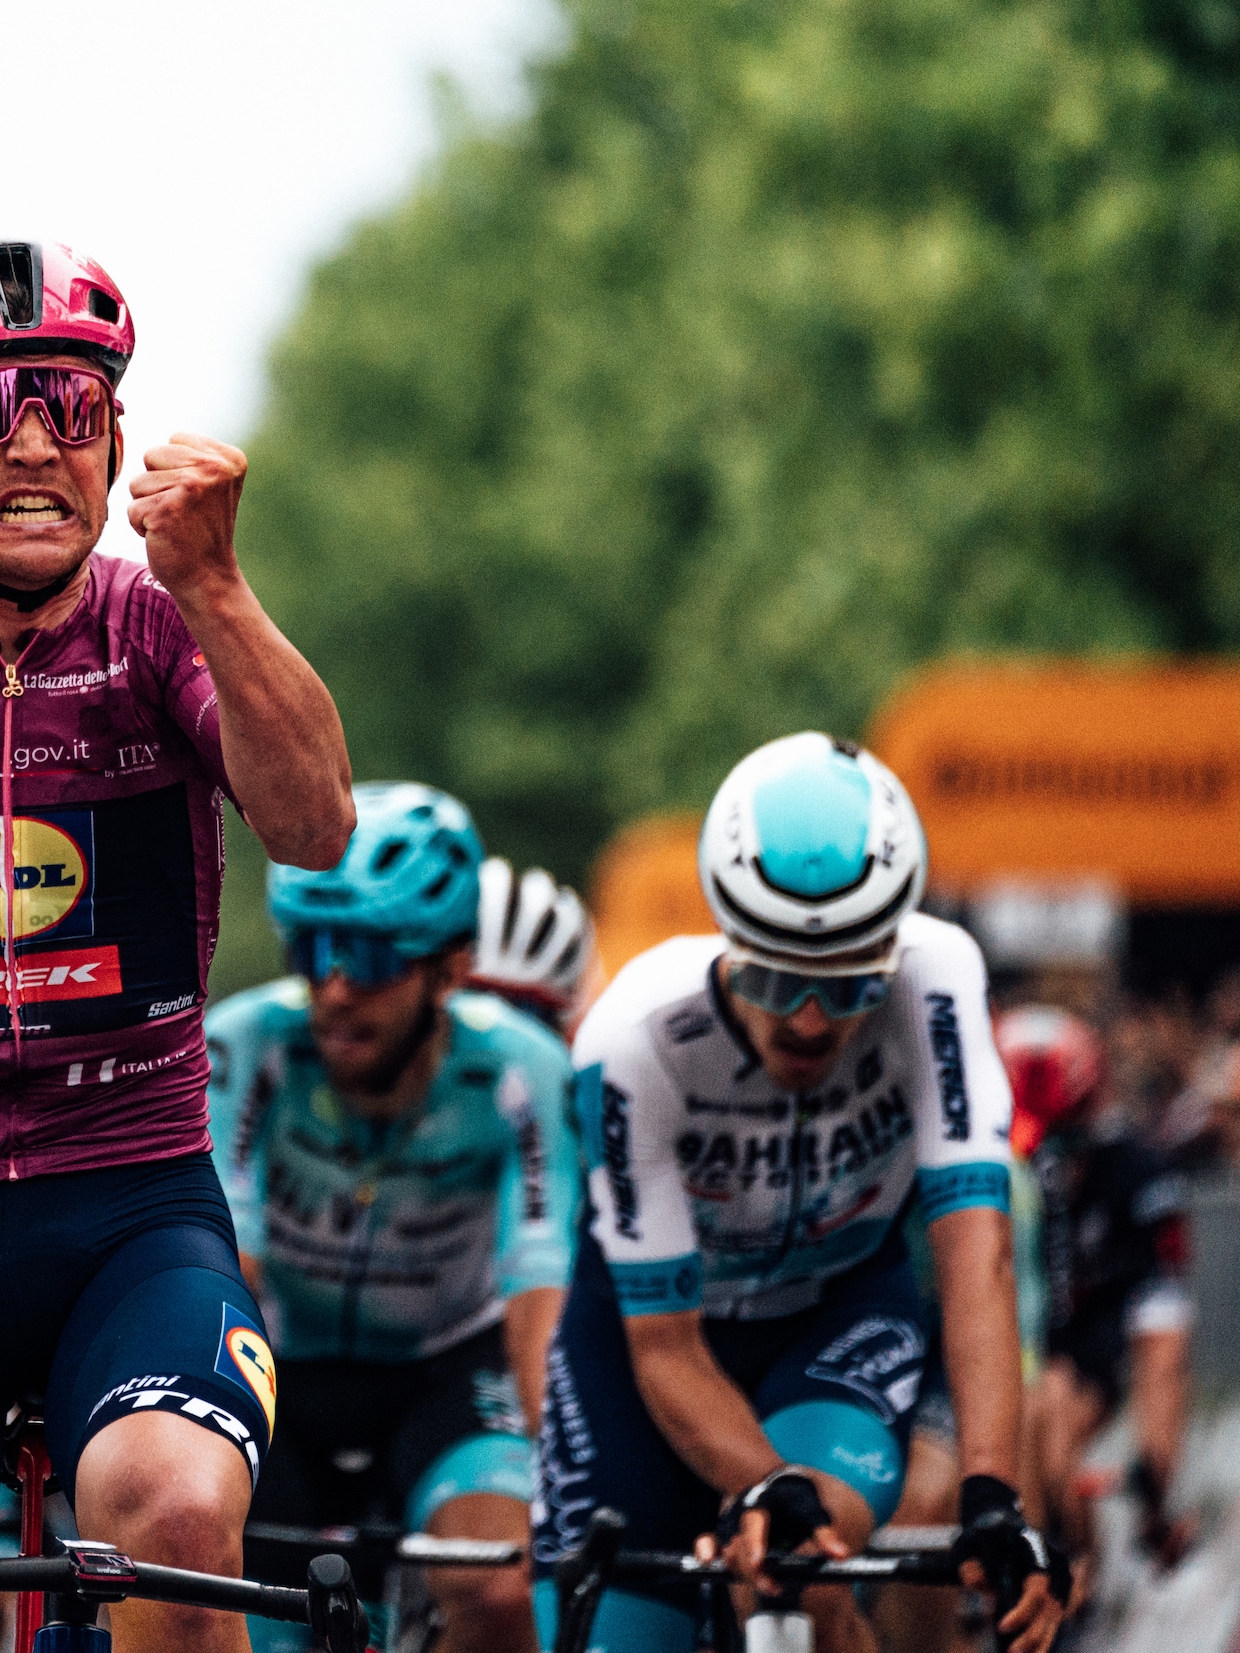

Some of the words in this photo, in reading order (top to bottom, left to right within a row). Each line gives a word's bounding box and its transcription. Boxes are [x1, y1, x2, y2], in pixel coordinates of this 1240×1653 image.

[24, 674, 36, 689] La
[38, 673, 84, 689] Gazzetta
[85, 670, 108, 685] dello
[104, 769, 115, 779] by
[147, 990, 196, 1018] Santini
[96, 1566, 121, 1575] wahoo
